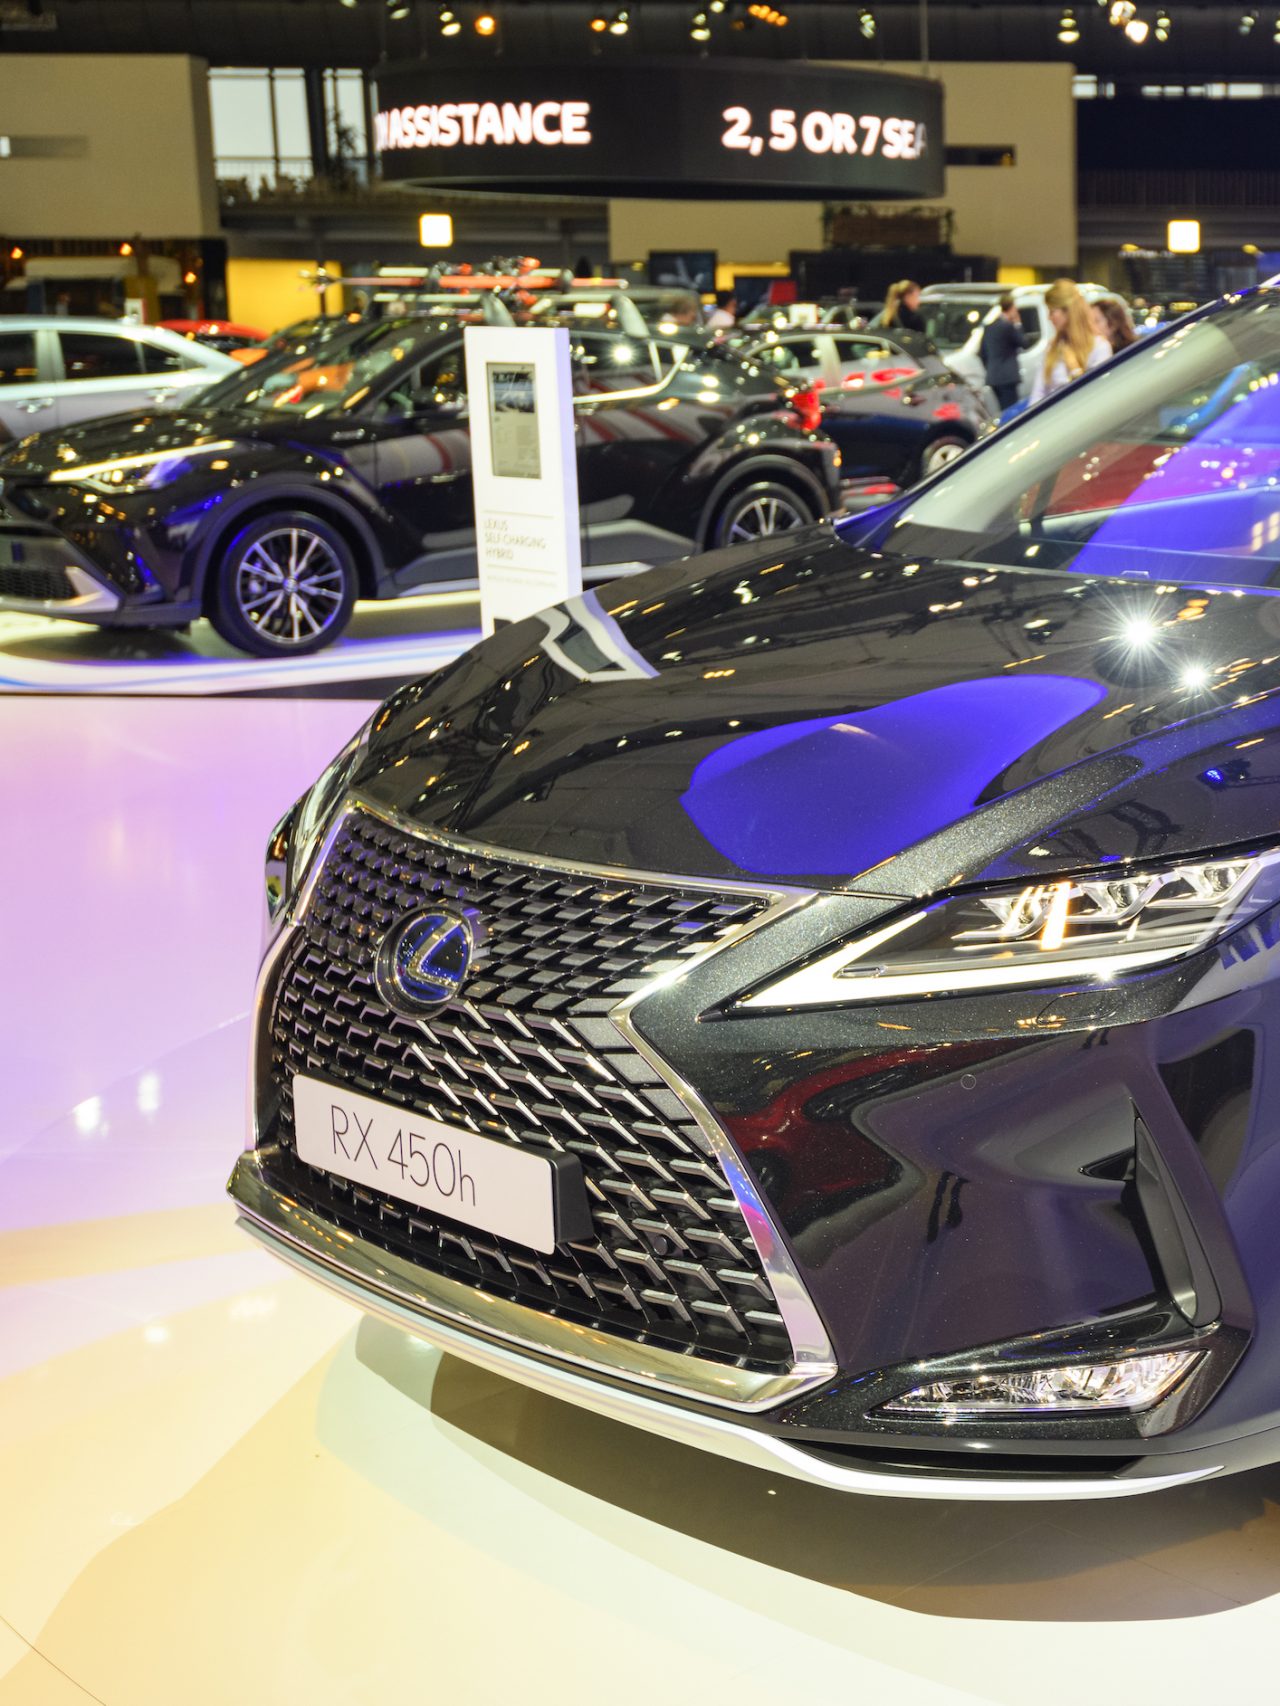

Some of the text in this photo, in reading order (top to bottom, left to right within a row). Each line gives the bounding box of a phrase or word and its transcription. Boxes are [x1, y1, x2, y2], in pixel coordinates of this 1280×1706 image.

[388, 101, 592, 150] ASSISTANCE
[801, 110, 858, 155] OR
[858, 115, 882, 156] 7
[330, 1104, 476, 1207] RX 450h
